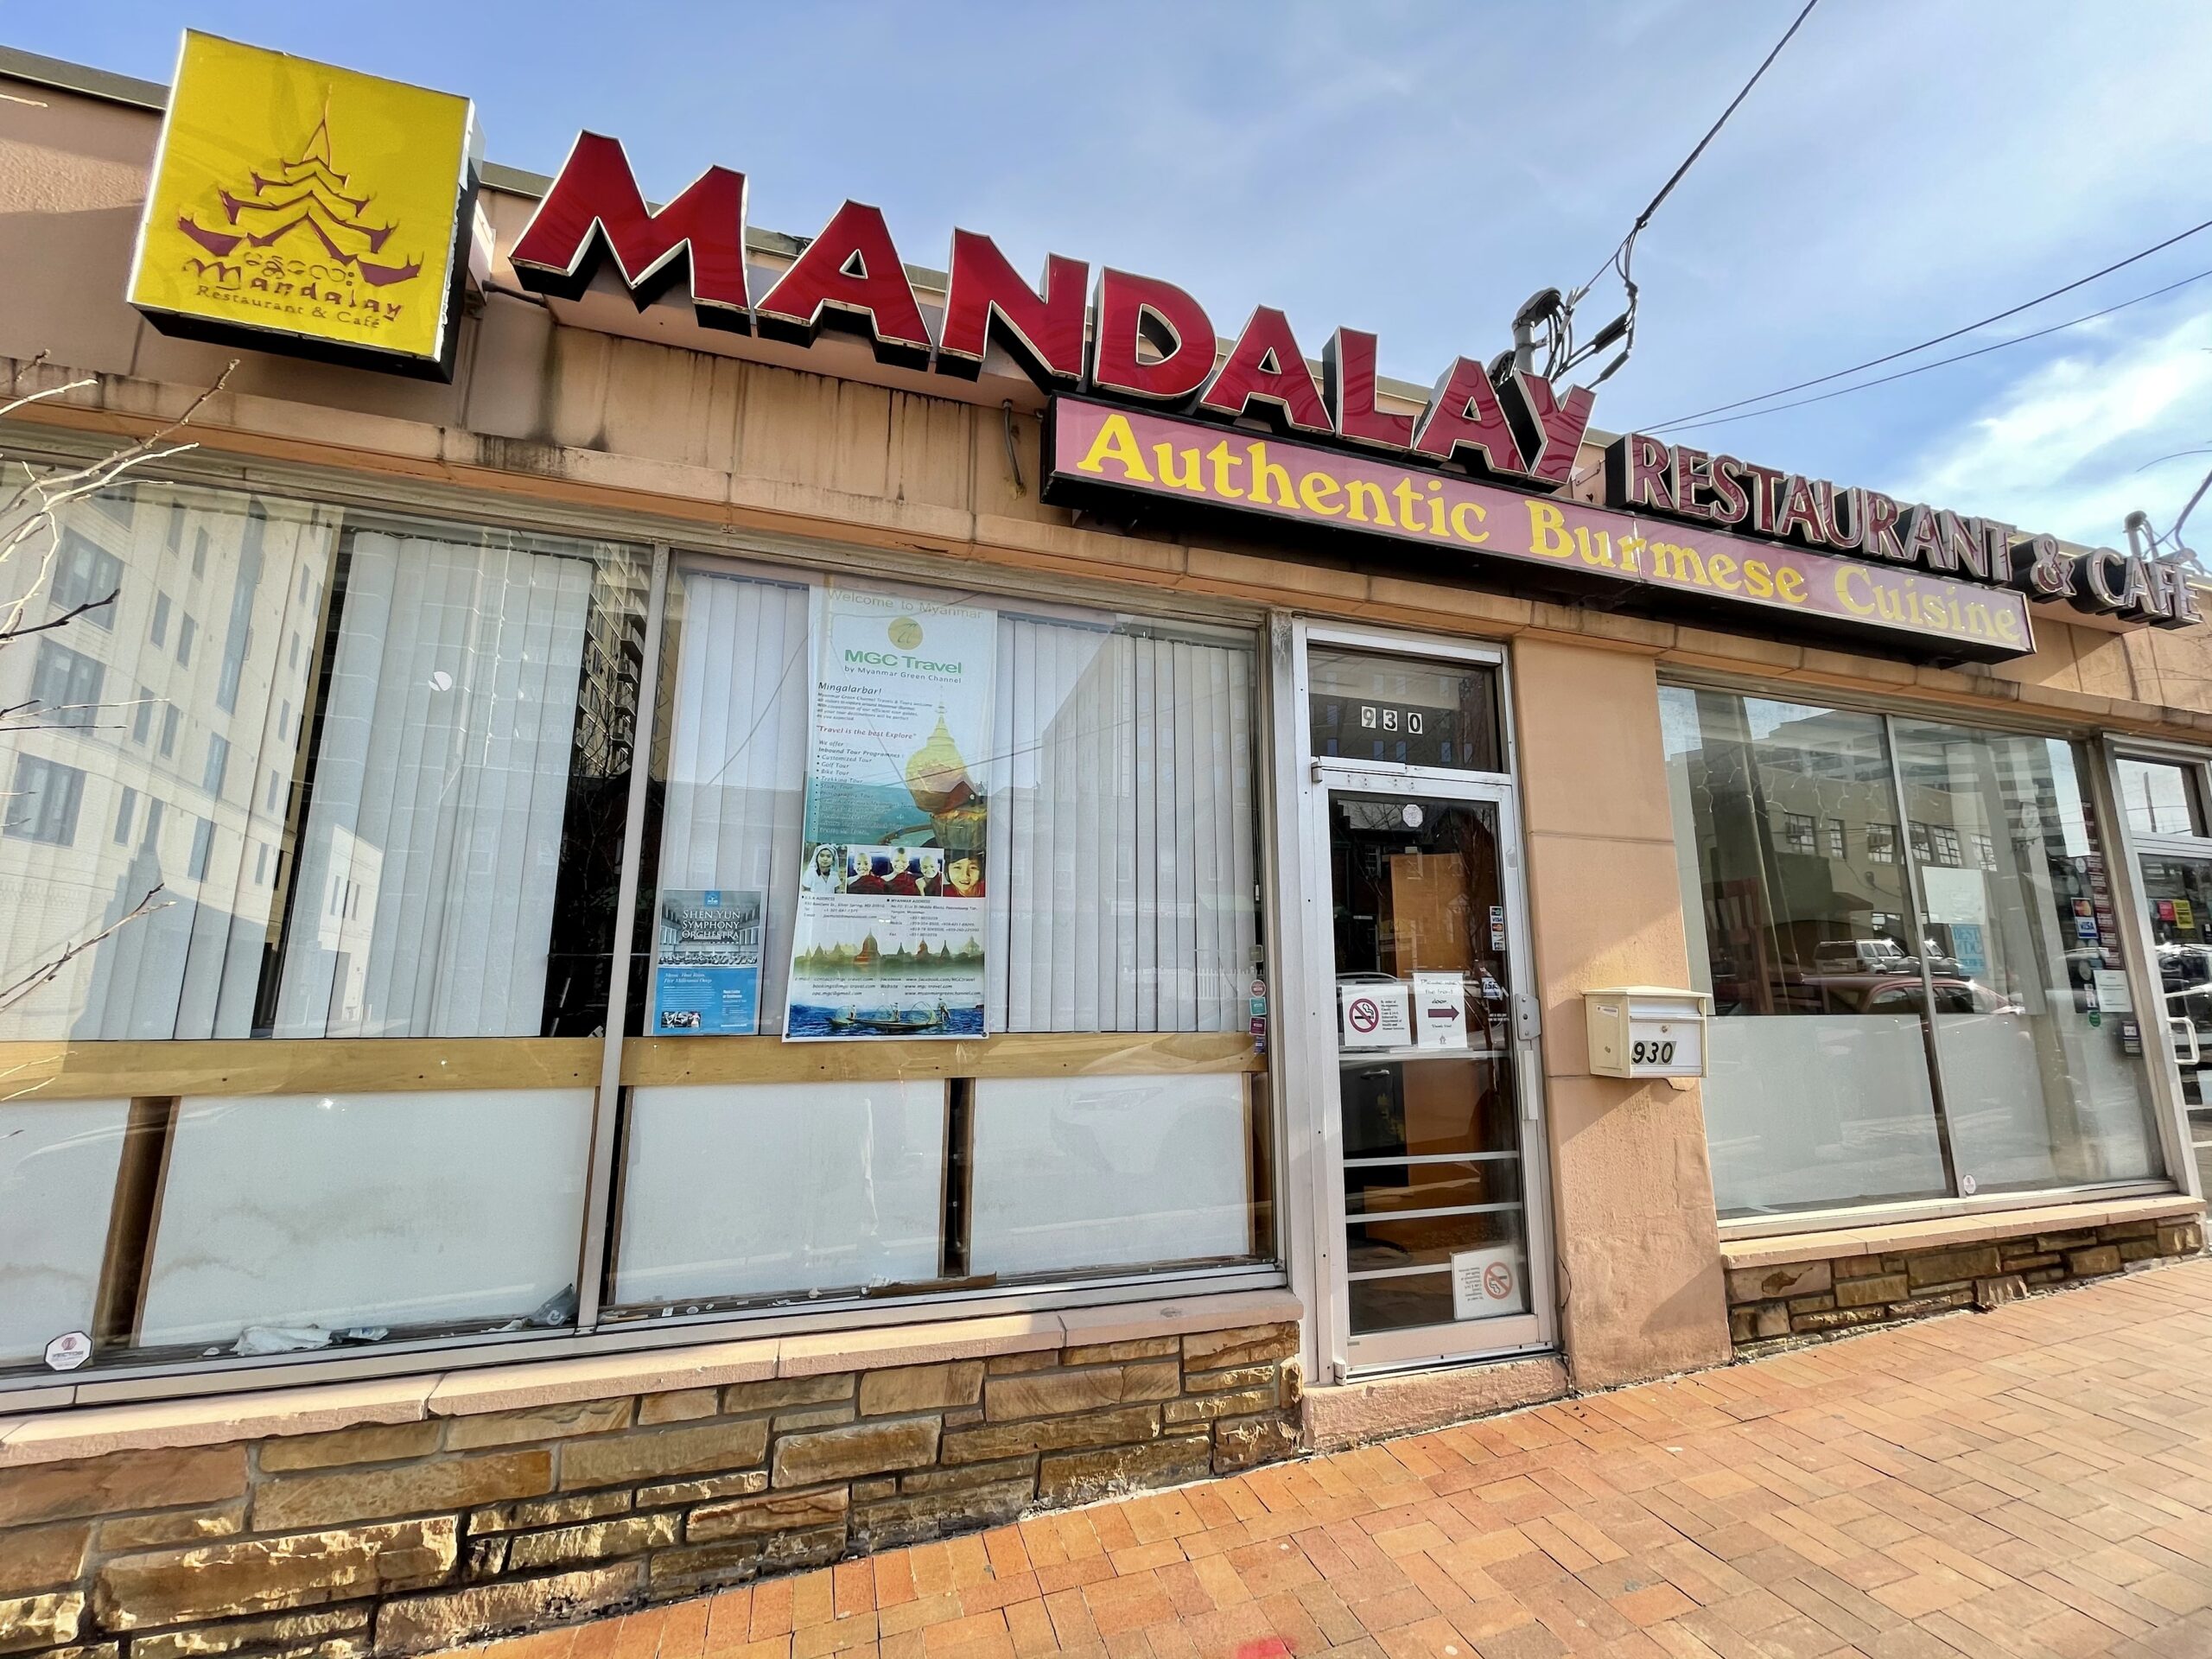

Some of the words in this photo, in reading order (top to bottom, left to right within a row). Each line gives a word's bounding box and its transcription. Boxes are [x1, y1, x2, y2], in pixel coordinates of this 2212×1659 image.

[195, 284, 304, 315] Restaurant
[311, 306, 327, 320] &
[336, 310, 382, 329] Café
[507, 129, 1598, 486] MANDALAY
[1623, 432, 2018, 585] RESTAURANT
[2030, 532, 2076, 598] &
[1076, 413, 1490, 543] Authentic
[1524, 499, 1808, 604] Burmese
[1834, 564, 2024, 645] Cuisine
[828, 589, 893, 608] Welcome
[901, 601, 914, 611] to
[919, 602, 983, 620] Myanmar
[844, 649, 899, 667] MGC
[901, 655, 963, 674] Travel
[844, 665, 855, 674] by
[857, 667, 898, 678] Myanmar
[900, 671, 925, 681] Green
[928, 674, 962, 684] Channel
[817, 681, 882, 696] Mingalarbar!
[1363, 707, 1422, 734] 930
[682, 919, 741, 930] SYMPHONY
[683, 909, 714, 920] SHEN
[715, 910, 741, 920] YUN
[2080, 921, 2095, 931] VISA
[681, 930, 741, 940] ORCHESTRA
[1631, 1041, 1674, 1065] 930
